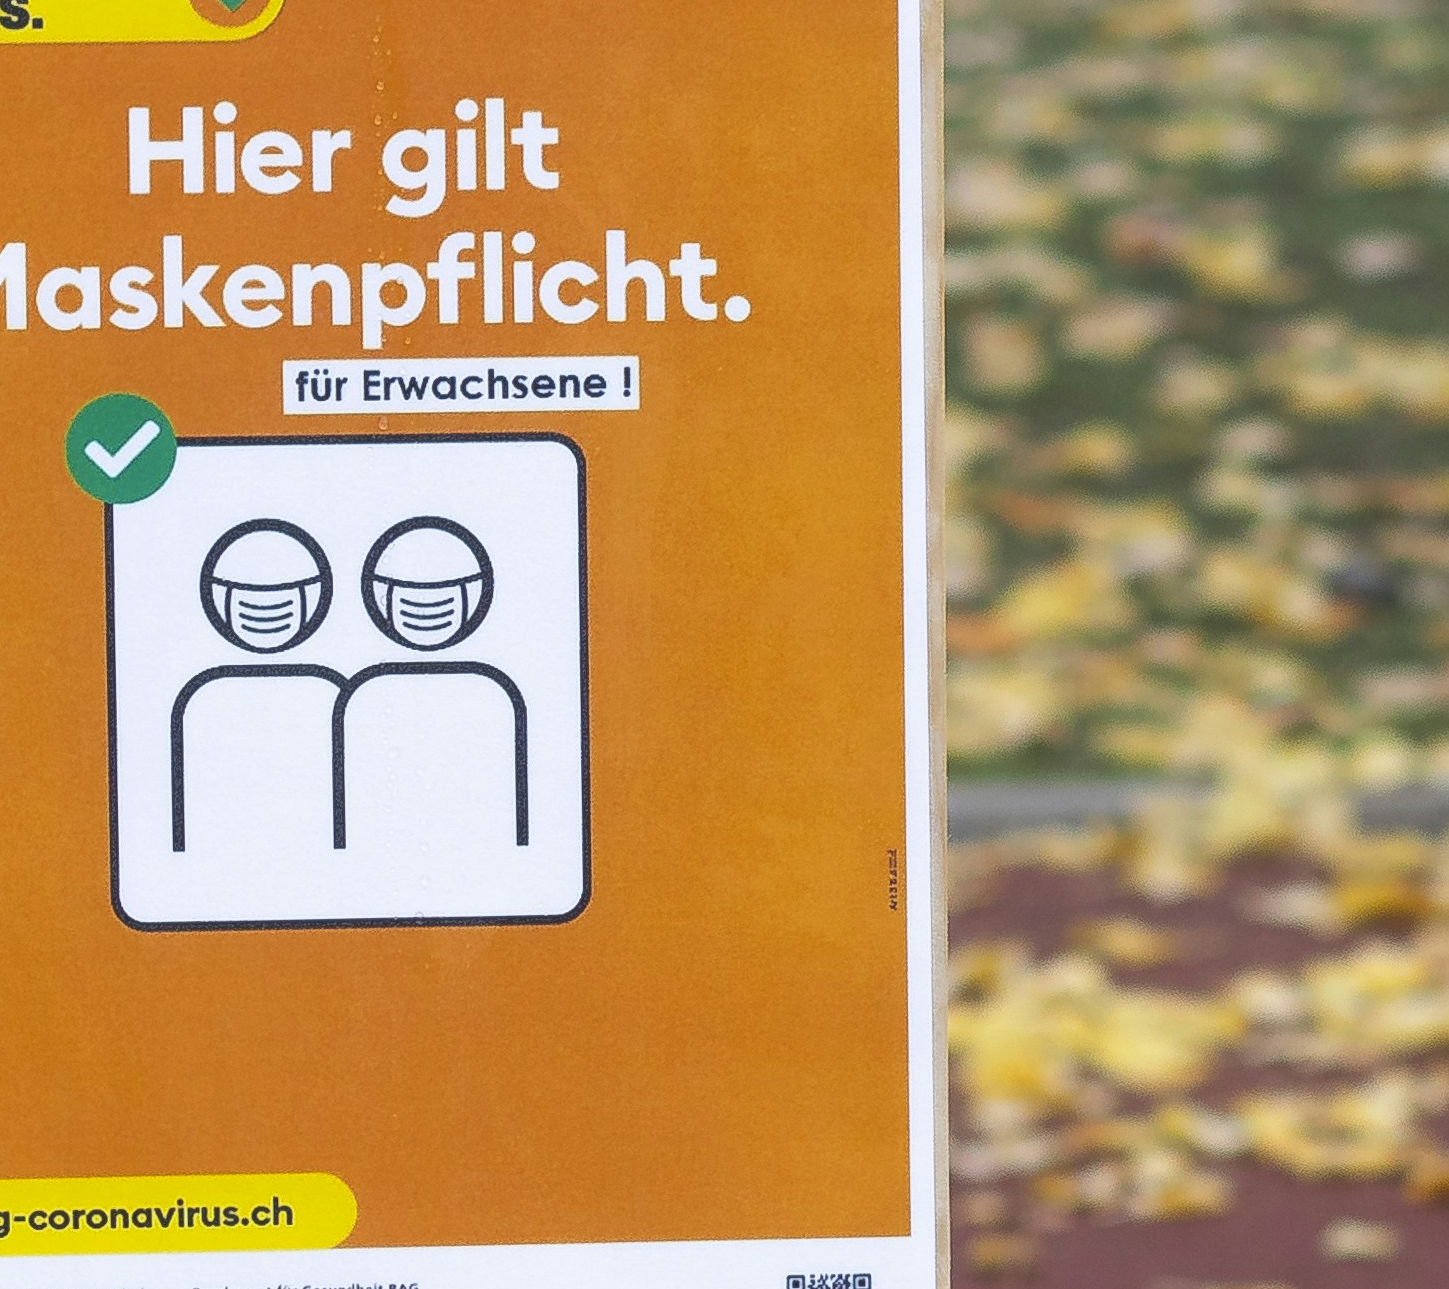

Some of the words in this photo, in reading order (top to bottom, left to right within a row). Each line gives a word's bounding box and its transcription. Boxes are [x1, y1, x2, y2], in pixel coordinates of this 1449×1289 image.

[128, 101, 350, 195] Hier
[382, 98, 560, 219] gilt
[295, 369, 348, 403] für
[362, 366, 607, 401] Erwachsene
